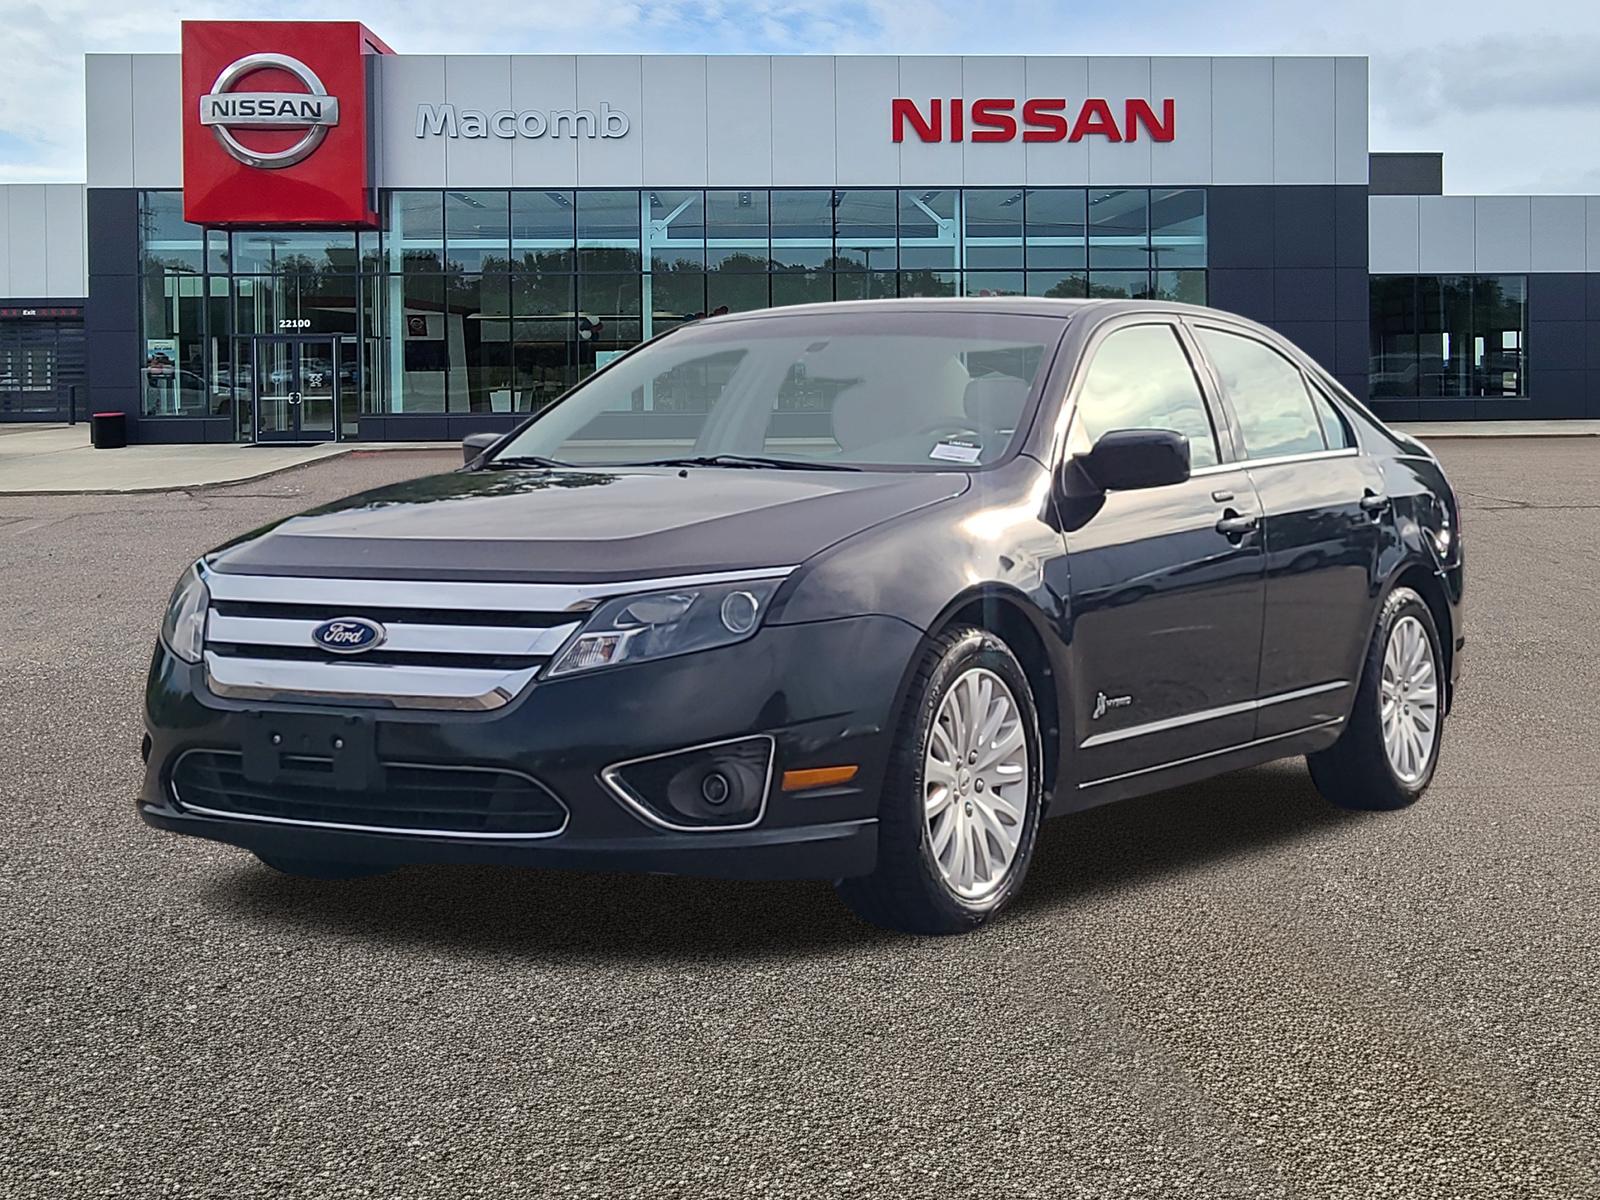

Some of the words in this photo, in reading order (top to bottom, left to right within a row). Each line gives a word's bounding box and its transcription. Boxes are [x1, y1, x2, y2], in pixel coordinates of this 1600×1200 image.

[212, 100, 321, 117] NISSAN
[416, 102, 630, 139] Macomb
[892, 98, 1175, 143] NISSAN
[279, 319, 311, 328] 22100
[323, 622, 365, 643] Ford
